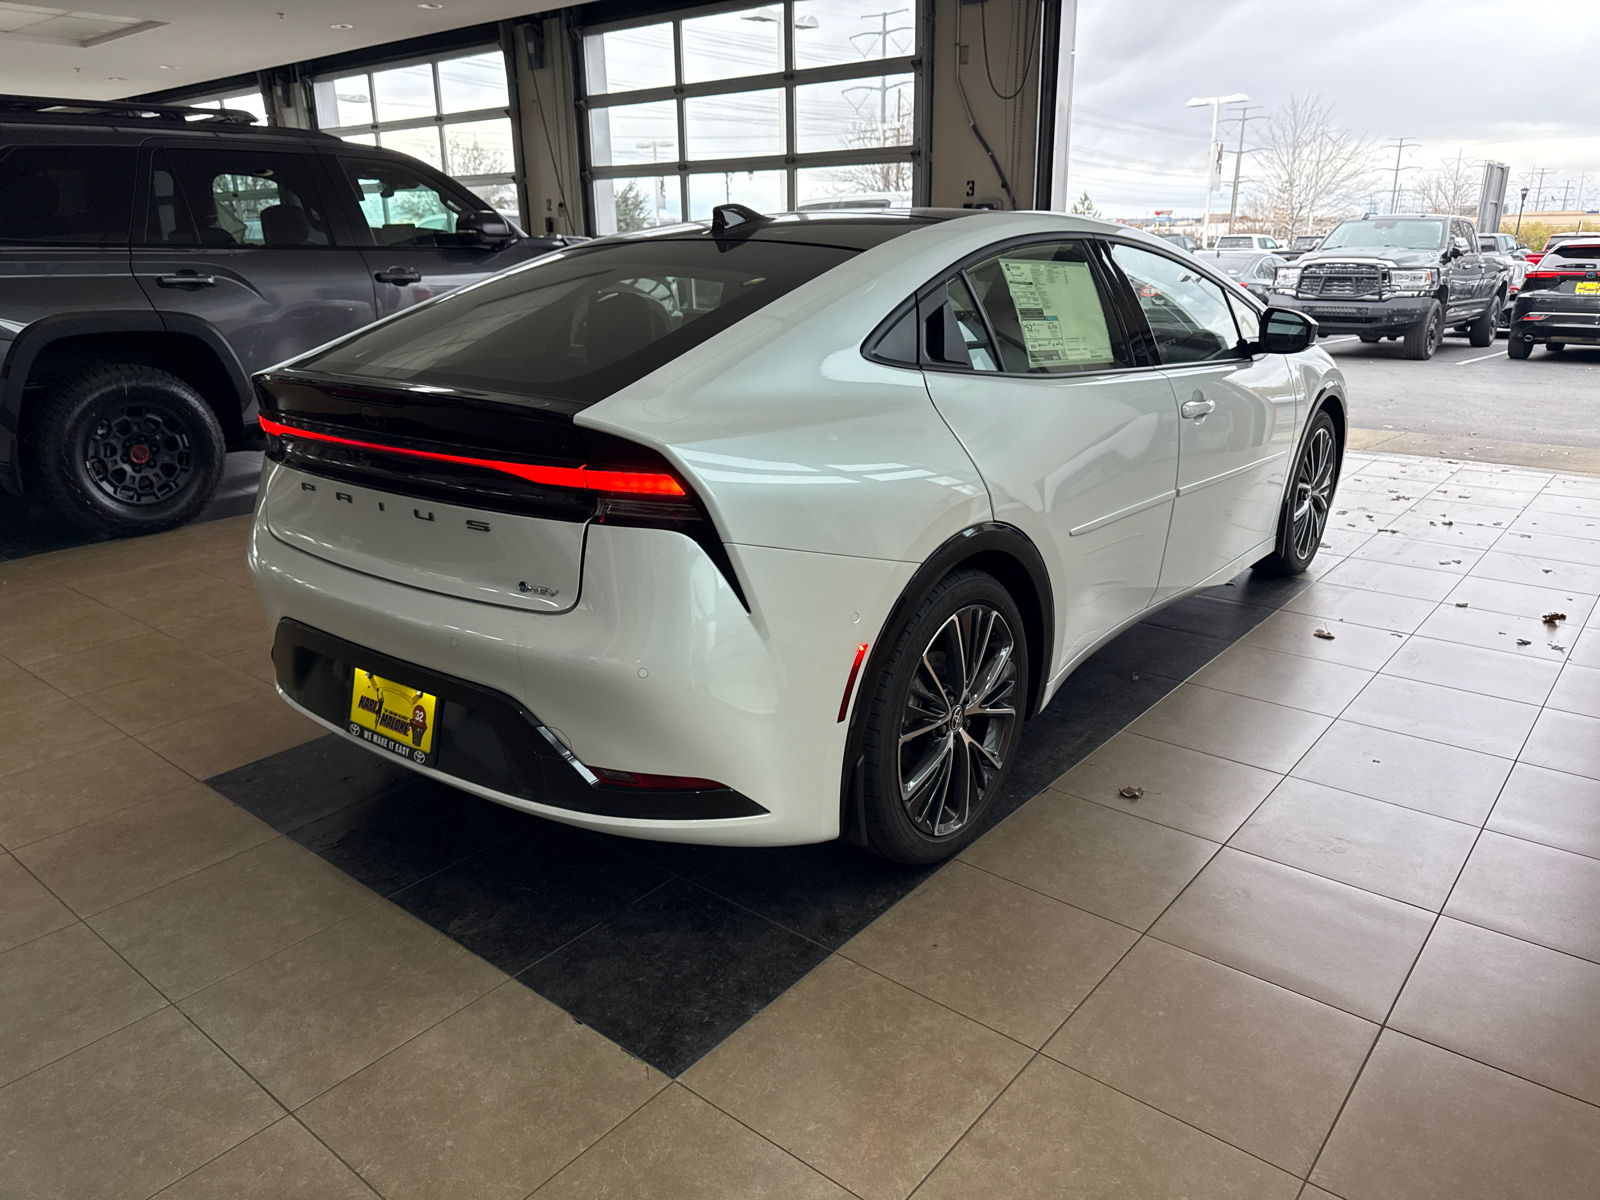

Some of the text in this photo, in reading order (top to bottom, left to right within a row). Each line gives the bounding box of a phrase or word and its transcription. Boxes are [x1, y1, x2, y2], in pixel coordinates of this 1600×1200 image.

[966, 180, 974, 196] 3
[546, 199, 552, 211] 2
[301, 482, 490, 532] PRIUS
[358, 695, 378, 714] KARL
[380, 714, 410, 736] MALONE
[415, 710, 424, 722] 32
[364, 730, 410, 756] WE MAKE IT EASY
